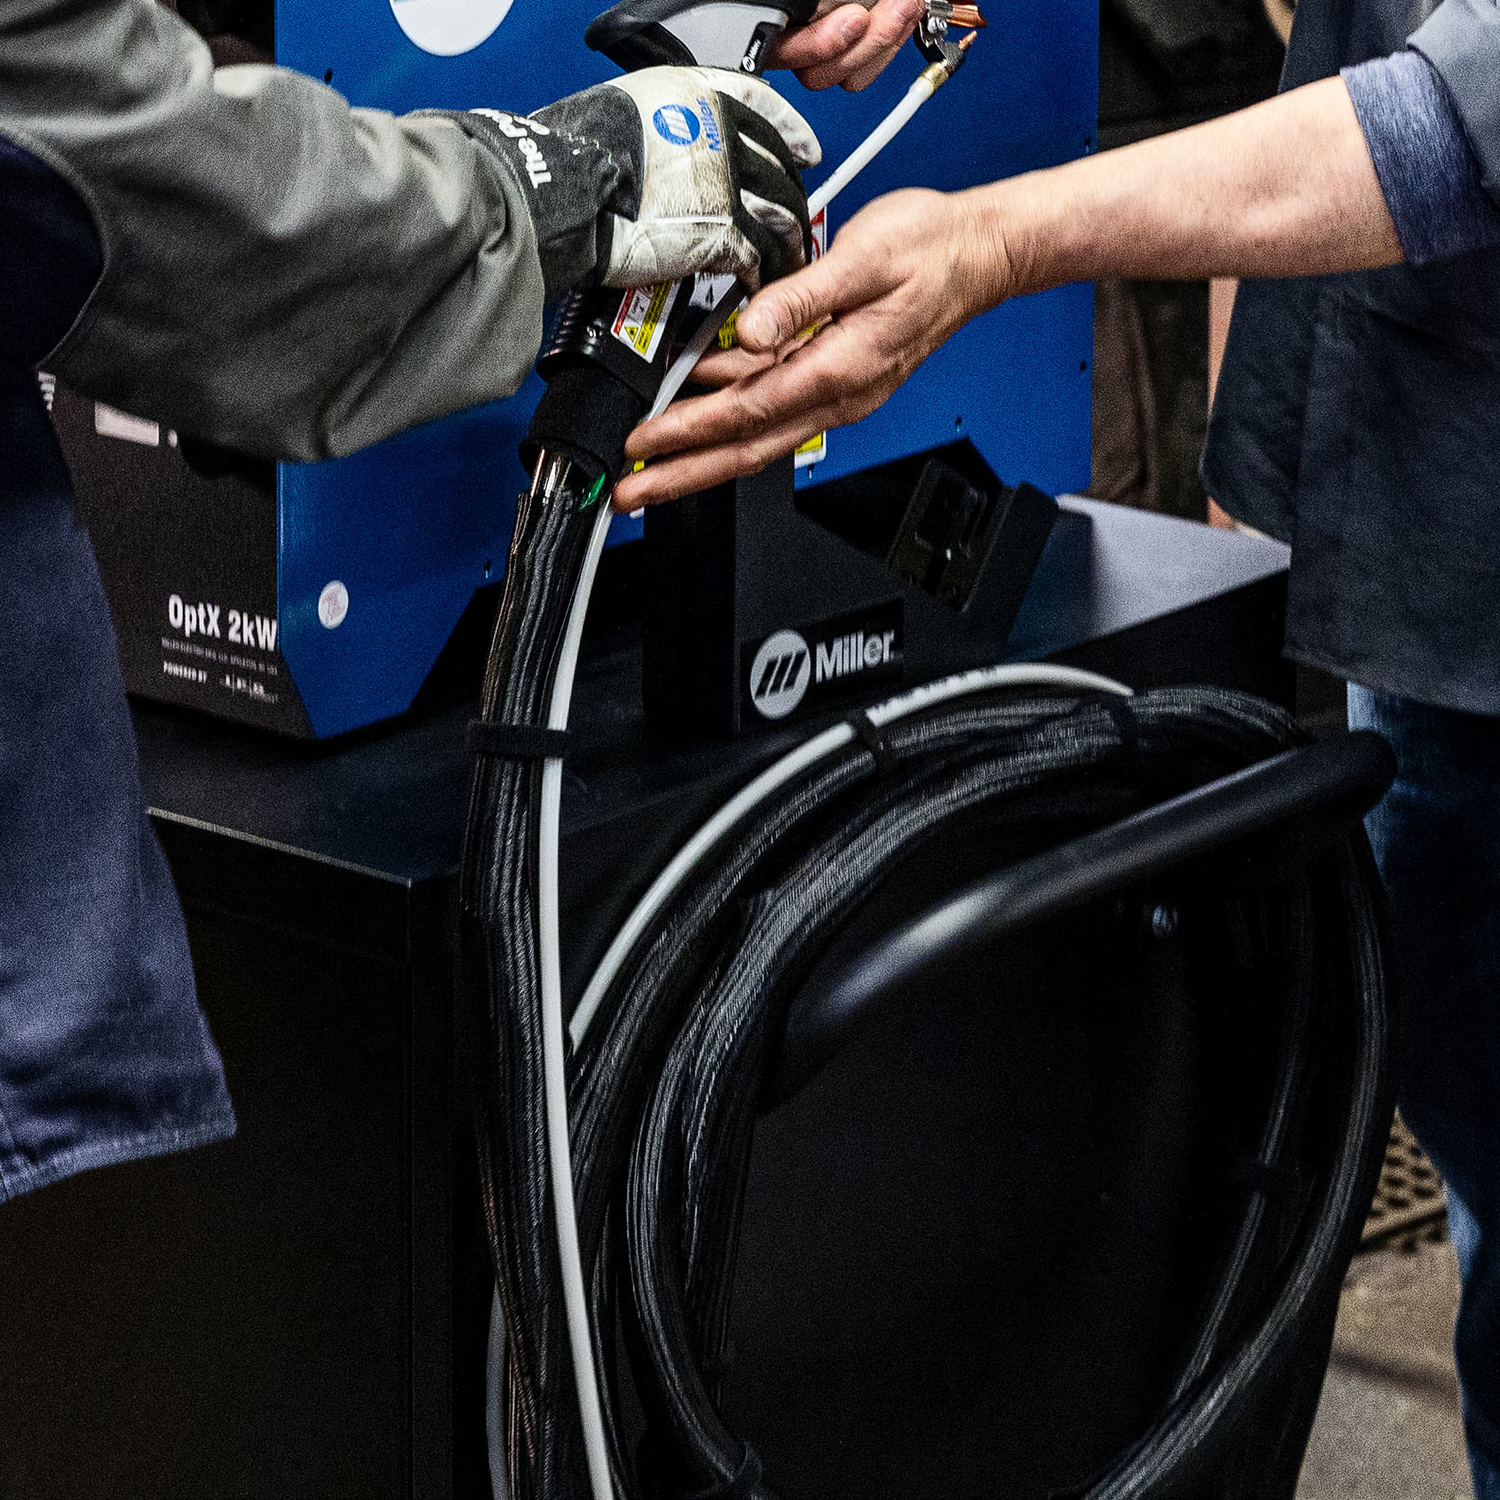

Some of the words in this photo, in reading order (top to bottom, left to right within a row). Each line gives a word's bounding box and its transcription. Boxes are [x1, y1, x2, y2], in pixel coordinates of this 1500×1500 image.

[696, 96, 722, 152] Miller
[518, 137, 552, 189] The
[168, 593, 221, 639] OptX
[227, 608, 278, 652] 2kW
[815, 629, 895, 683] Miller
